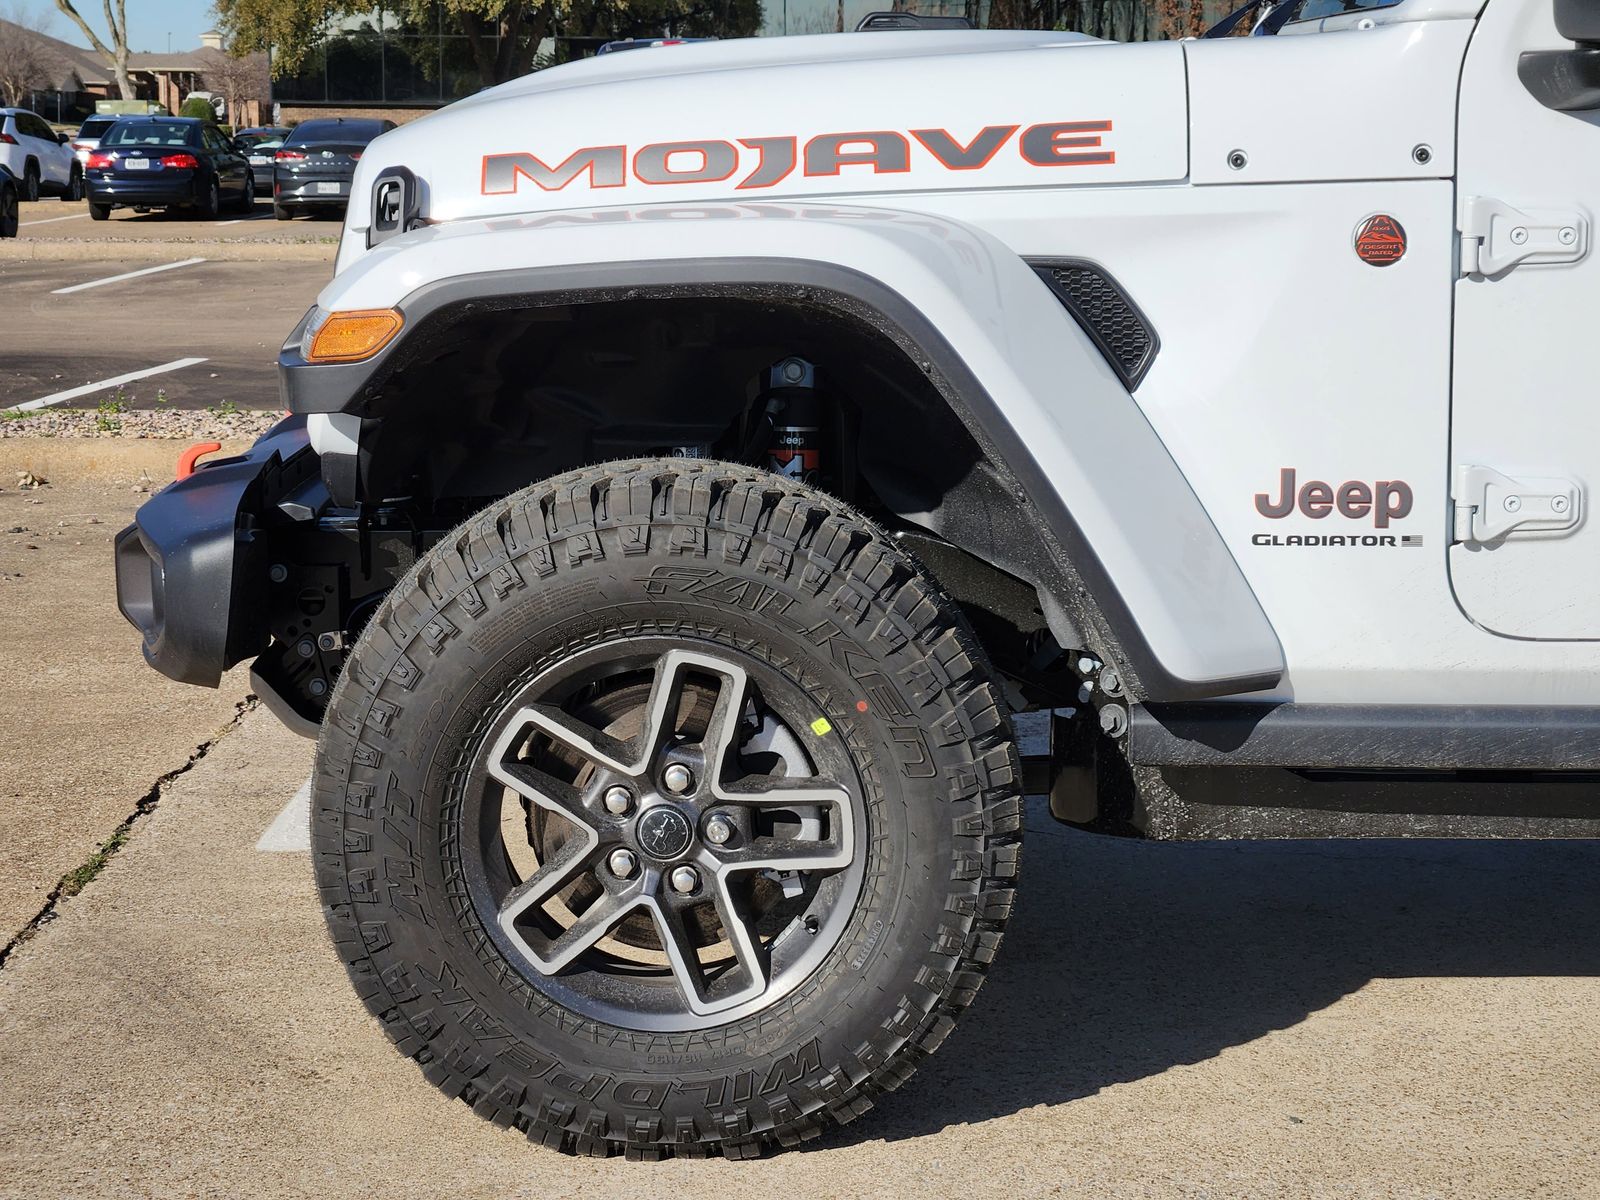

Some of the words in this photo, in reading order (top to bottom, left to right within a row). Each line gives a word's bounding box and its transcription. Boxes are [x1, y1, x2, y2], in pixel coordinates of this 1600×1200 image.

[481, 120, 1116, 196] MOJAVE
[779, 435, 806, 446] Jeep
[1254, 467, 1414, 529] Jeep
[1252, 533, 1398, 547] GLADIATOR
